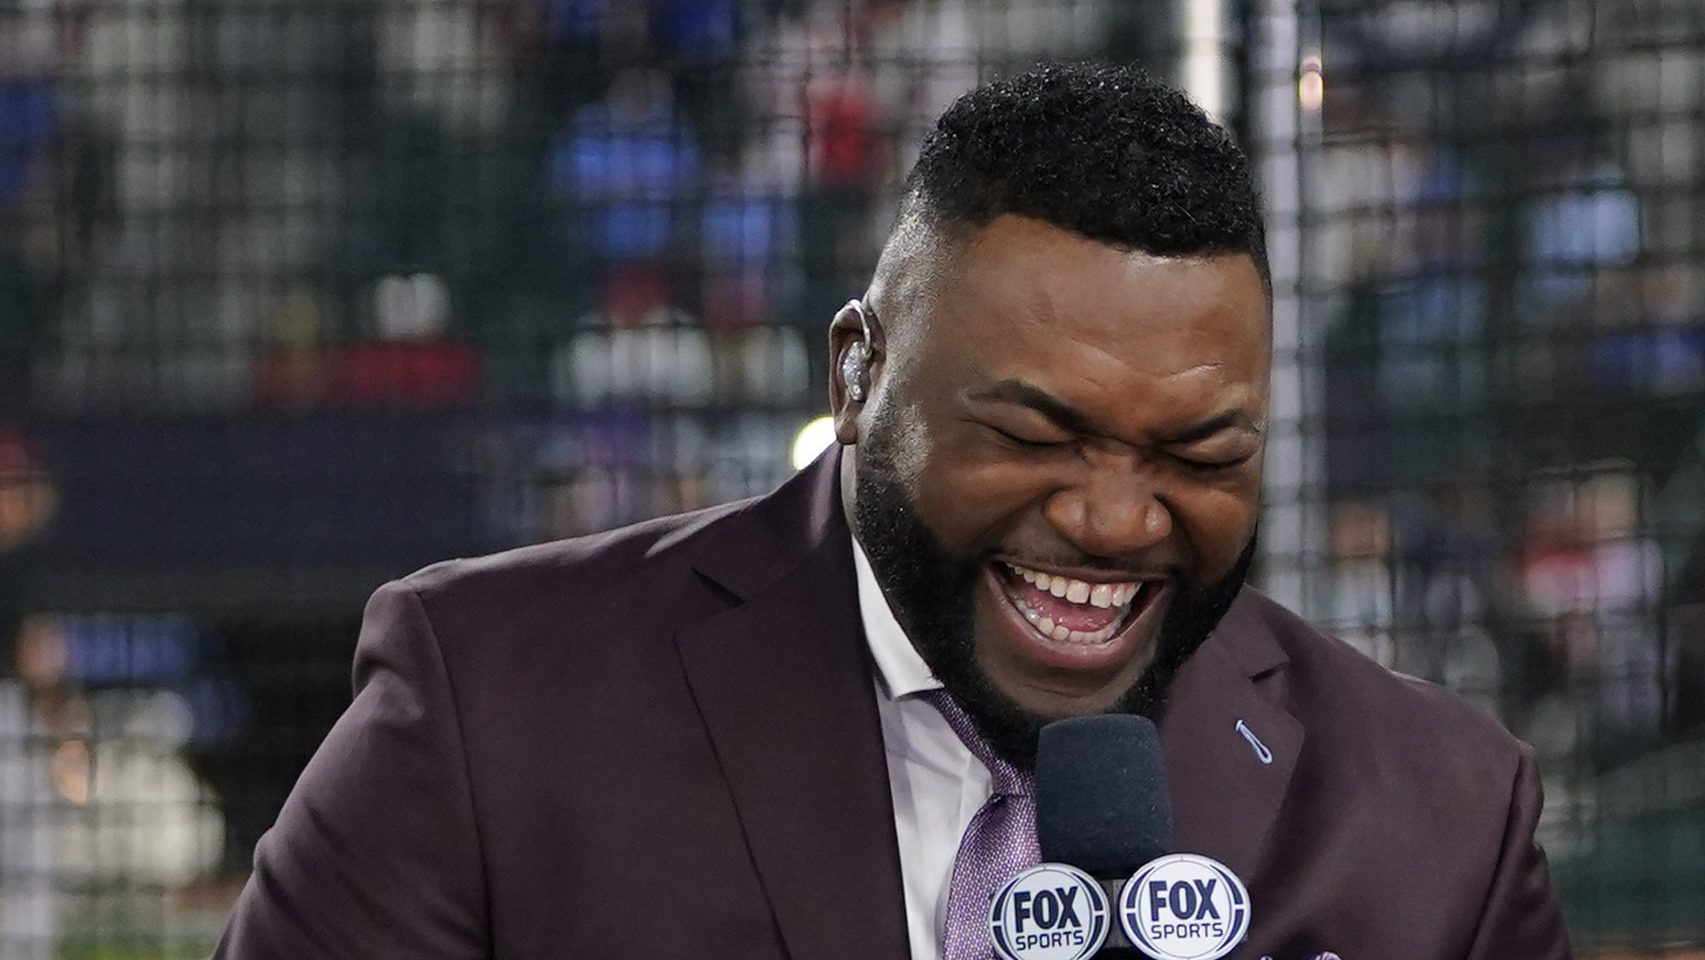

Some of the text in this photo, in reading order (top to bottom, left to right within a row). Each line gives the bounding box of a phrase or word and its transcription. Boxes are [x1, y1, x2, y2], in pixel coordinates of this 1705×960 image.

[1013, 886, 1081, 933] FOX
[1149, 878, 1220, 921] FOX
[1016, 930, 1084, 950] SPORTS
[1151, 922, 1223, 940] SPORTS
